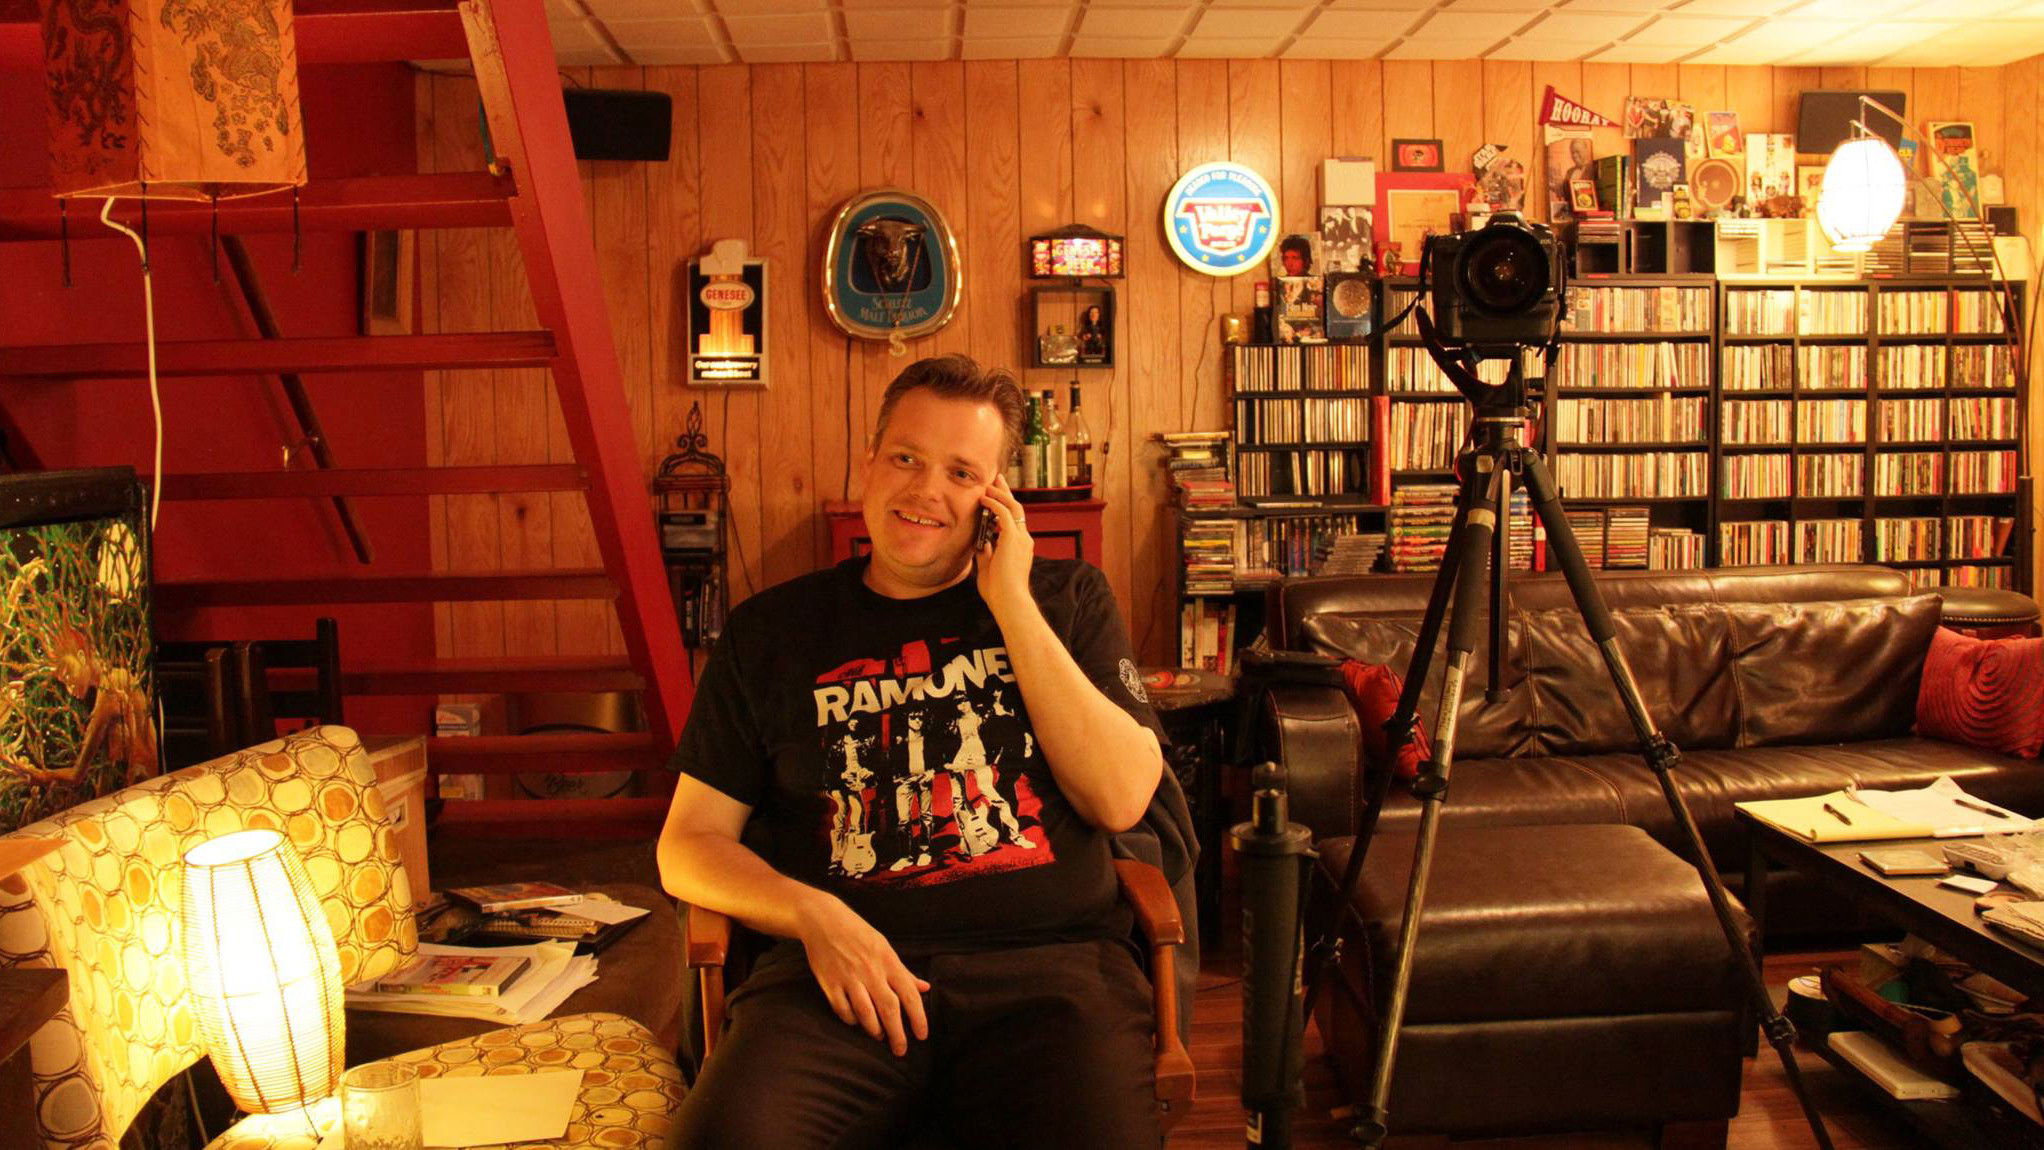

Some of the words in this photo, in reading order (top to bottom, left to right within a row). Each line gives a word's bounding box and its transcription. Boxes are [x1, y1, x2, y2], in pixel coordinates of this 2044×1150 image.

[1550, 97, 1609, 127] HOORAY
[705, 288, 747, 301] GENESEE
[813, 646, 1018, 727] RAMONE
